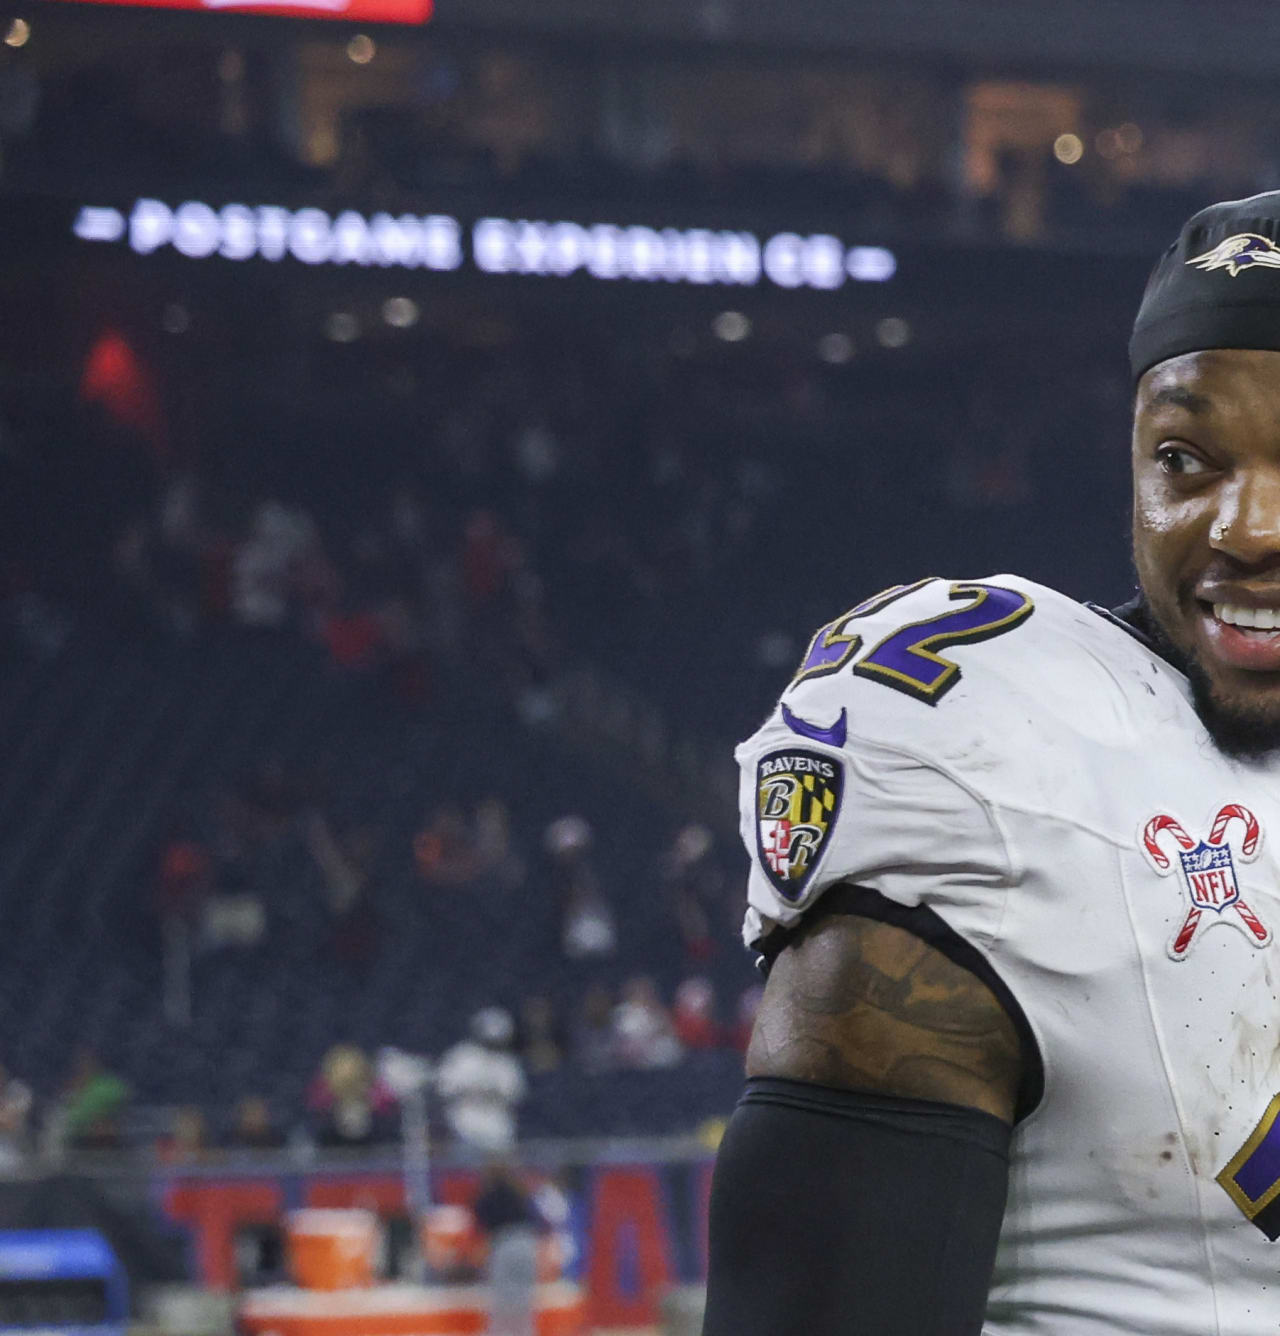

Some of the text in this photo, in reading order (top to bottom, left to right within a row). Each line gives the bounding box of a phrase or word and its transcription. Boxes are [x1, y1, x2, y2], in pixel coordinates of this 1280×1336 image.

[129, 199, 846, 289] POSTGAME EXPERIENCE
[789, 577, 1034, 708] 22
[760, 756, 835, 778] RAVENS
[1190, 871, 1237, 904] NFL
